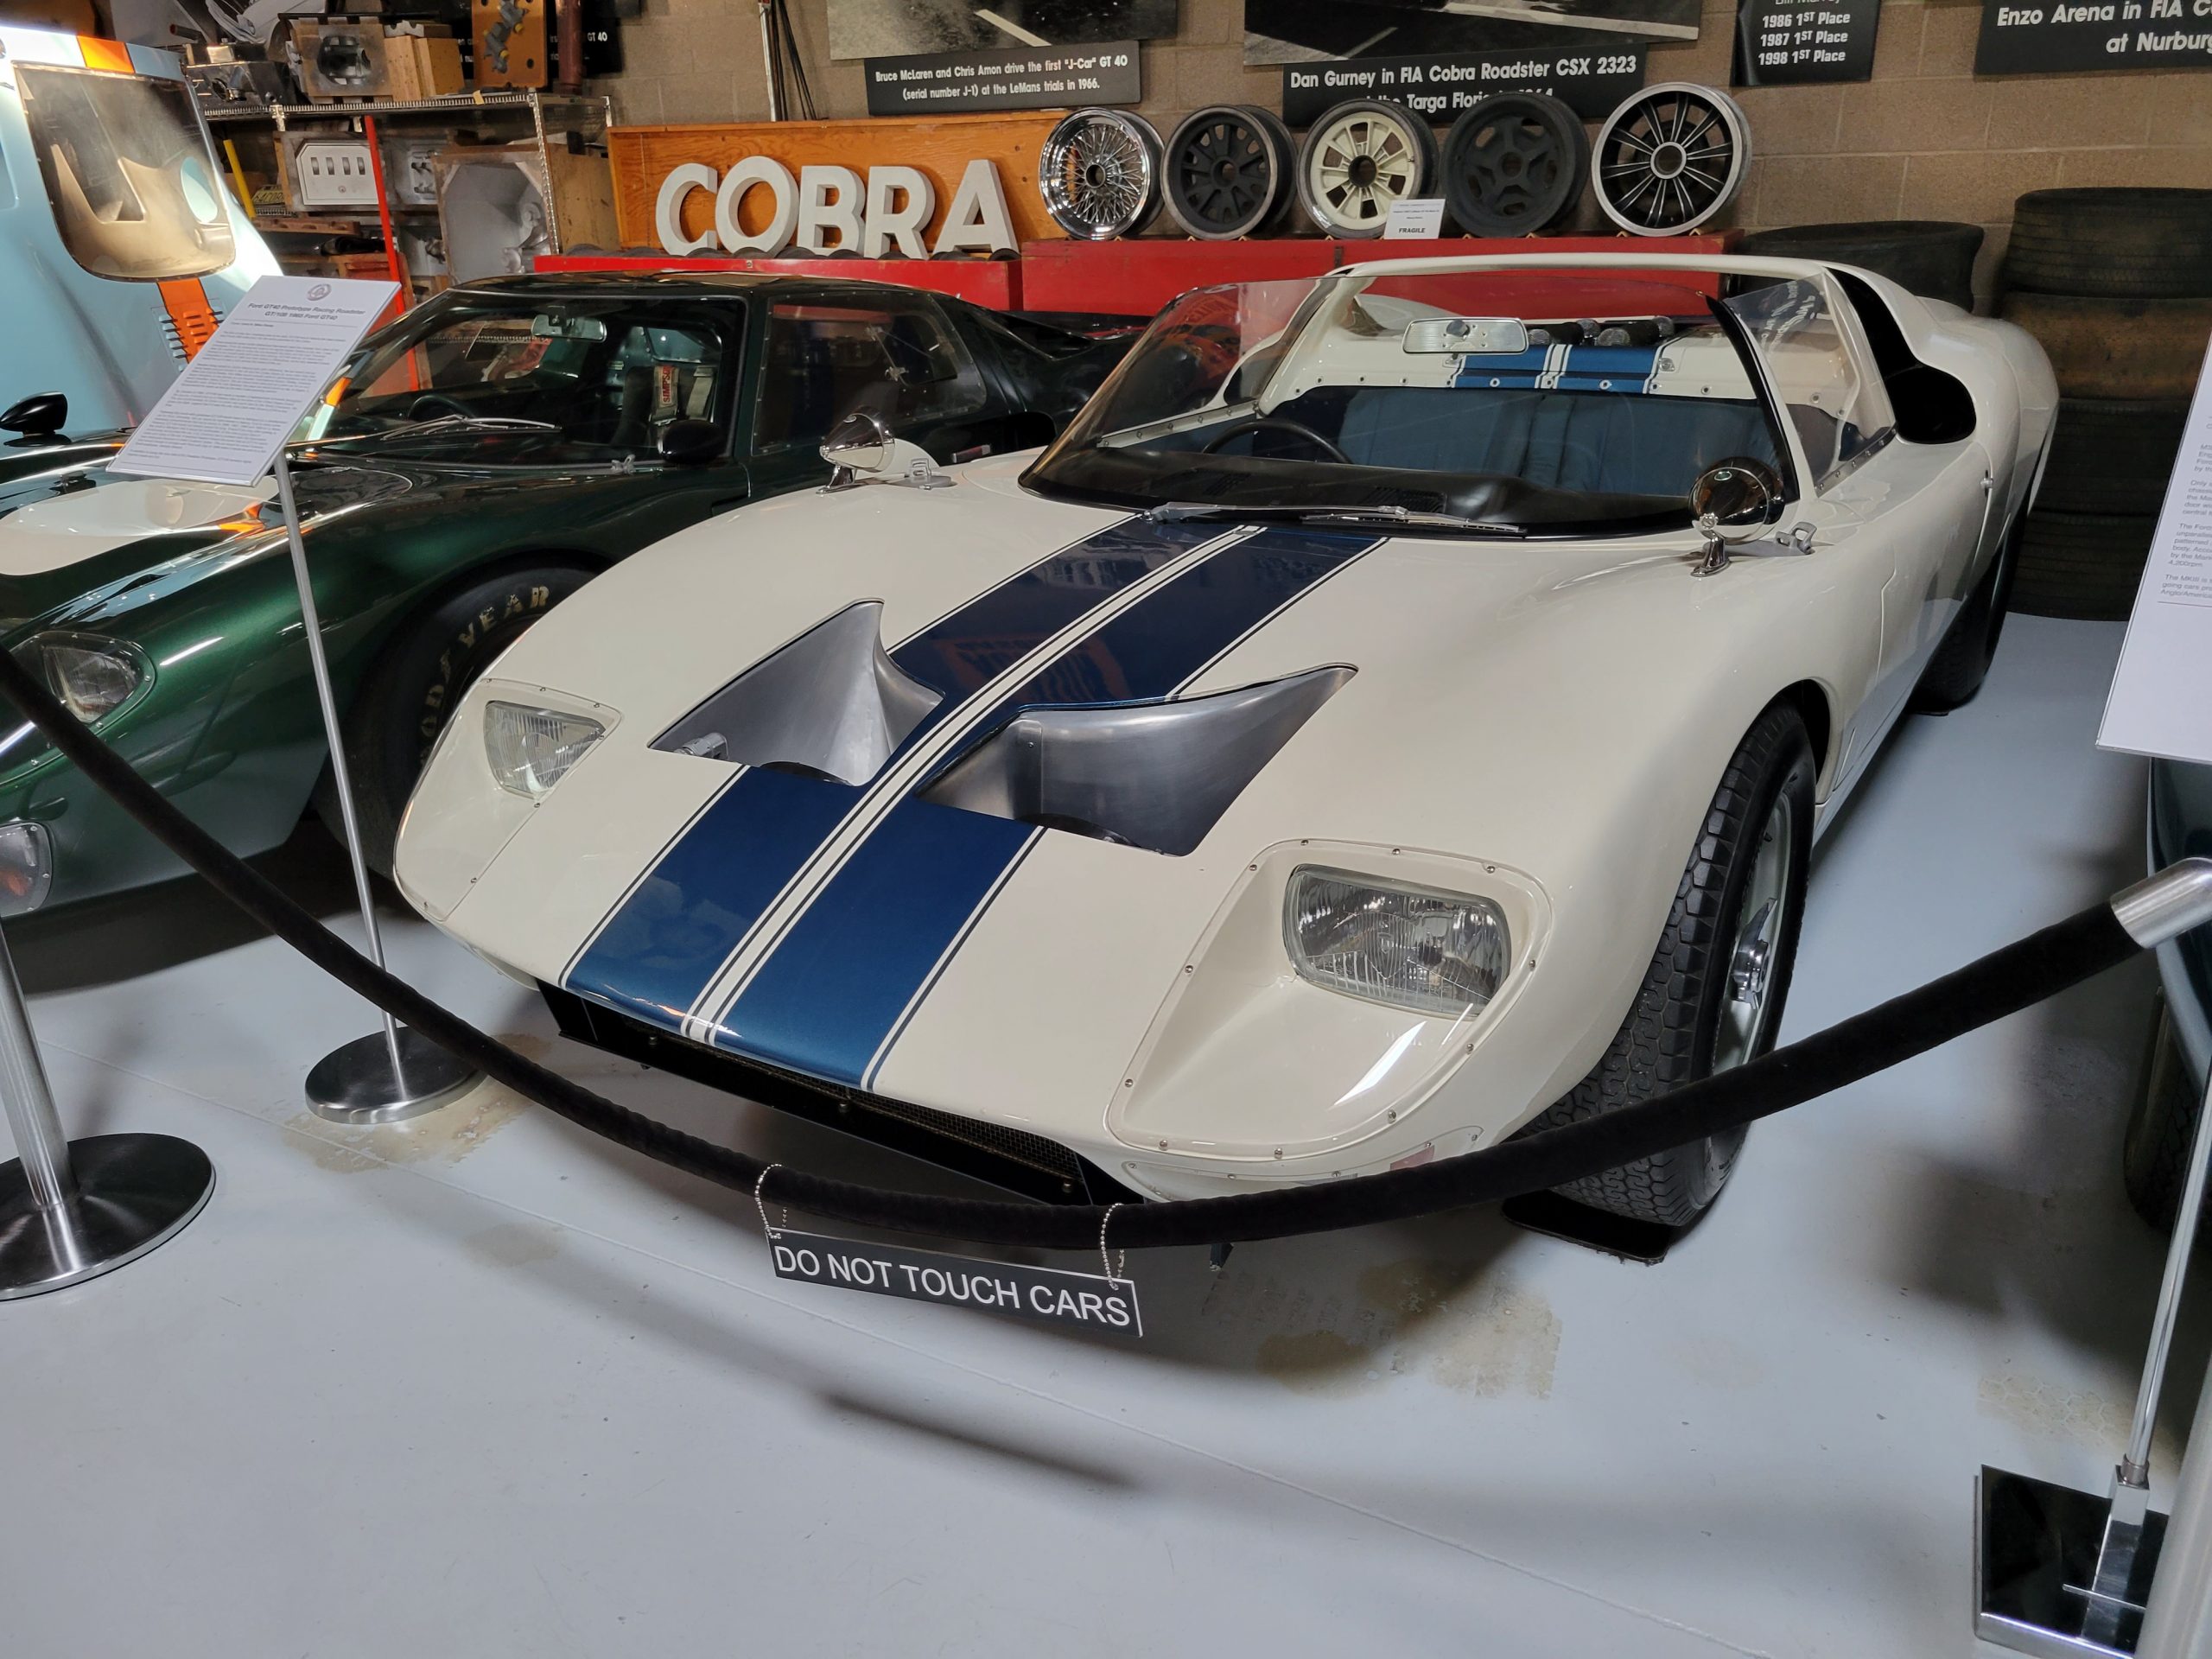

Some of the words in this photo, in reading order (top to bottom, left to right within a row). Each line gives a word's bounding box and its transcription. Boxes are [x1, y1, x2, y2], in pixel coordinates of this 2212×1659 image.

[1762, 14, 1793, 29] 1986
[1796, 11, 1816, 27] 1ST
[1817, 10, 1851, 25] Place
[1997, 6, 2044, 27] Enzo
[2050, 3, 2115, 23] Arena
[2121, 1, 2142, 20] in
[2150, 0, 2183, 19] FIA
[587, 32, 596, 41] GT
[597, 31, 608, 41] 40
[1760, 32, 1790, 48] 1987
[1793, 30, 1814, 45] 1ST
[1815, 29, 1849, 44] Place
[2106, 33, 2129, 54] at
[874, 71, 898, 82] Bruce
[899, 69, 933, 80] McLaren
[935, 67, 952, 79] and
[954, 66, 976, 77] Chris
[977, 65, 1002, 75] Amon
[1004, 62, 1026, 74] drive
[1027, 61, 1042, 73] the
[1045, 60, 1062, 71] first
[1064, 56, 1096, 70] "J-Car"
[1099, 56, 1112, 67] GT
[1114, 54, 1128, 67] 40
[1758, 51, 1789, 66] 1998
[1791, 48, 1812, 64] 1ST
[1813, 48, 1847, 63] Place
[1290, 72, 1319, 88] Dan
[1324, 70, 1376, 89] Gurney
[1381, 67, 1395, 85] in
[1400, 66, 1424, 84] FIA
[1428, 65, 1476, 82] Cobra
[1480, 60, 1551, 80] Roadster
[1555, 57, 1592, 77] CSX
[1596, 54, 1637, 75] 2323
[902, 87, 928, 101] (serial
[930, 87, 961, 99] number
[963, 84, 979, 97] J-1)
[981, 85, 990, 95] at
[993, 83, 1007, 95] the
[1009, 82, 1041, 94] LeMans
[1044, 80, 1065, 92] trials
[1067, 79, 1076, 90] in
[1078, 78, 1101, 90] 1966.
[1406, 92, 1447, 114] Targa
[655, 156, 1020, 260] COBRA
[773, 1245, 821, 1276] DO
[826, 1253, 892, 1287] NOT
[899, 1264, 1020, 1309] TOUCH
[1030, 1285, 1131, 1327] CARS
